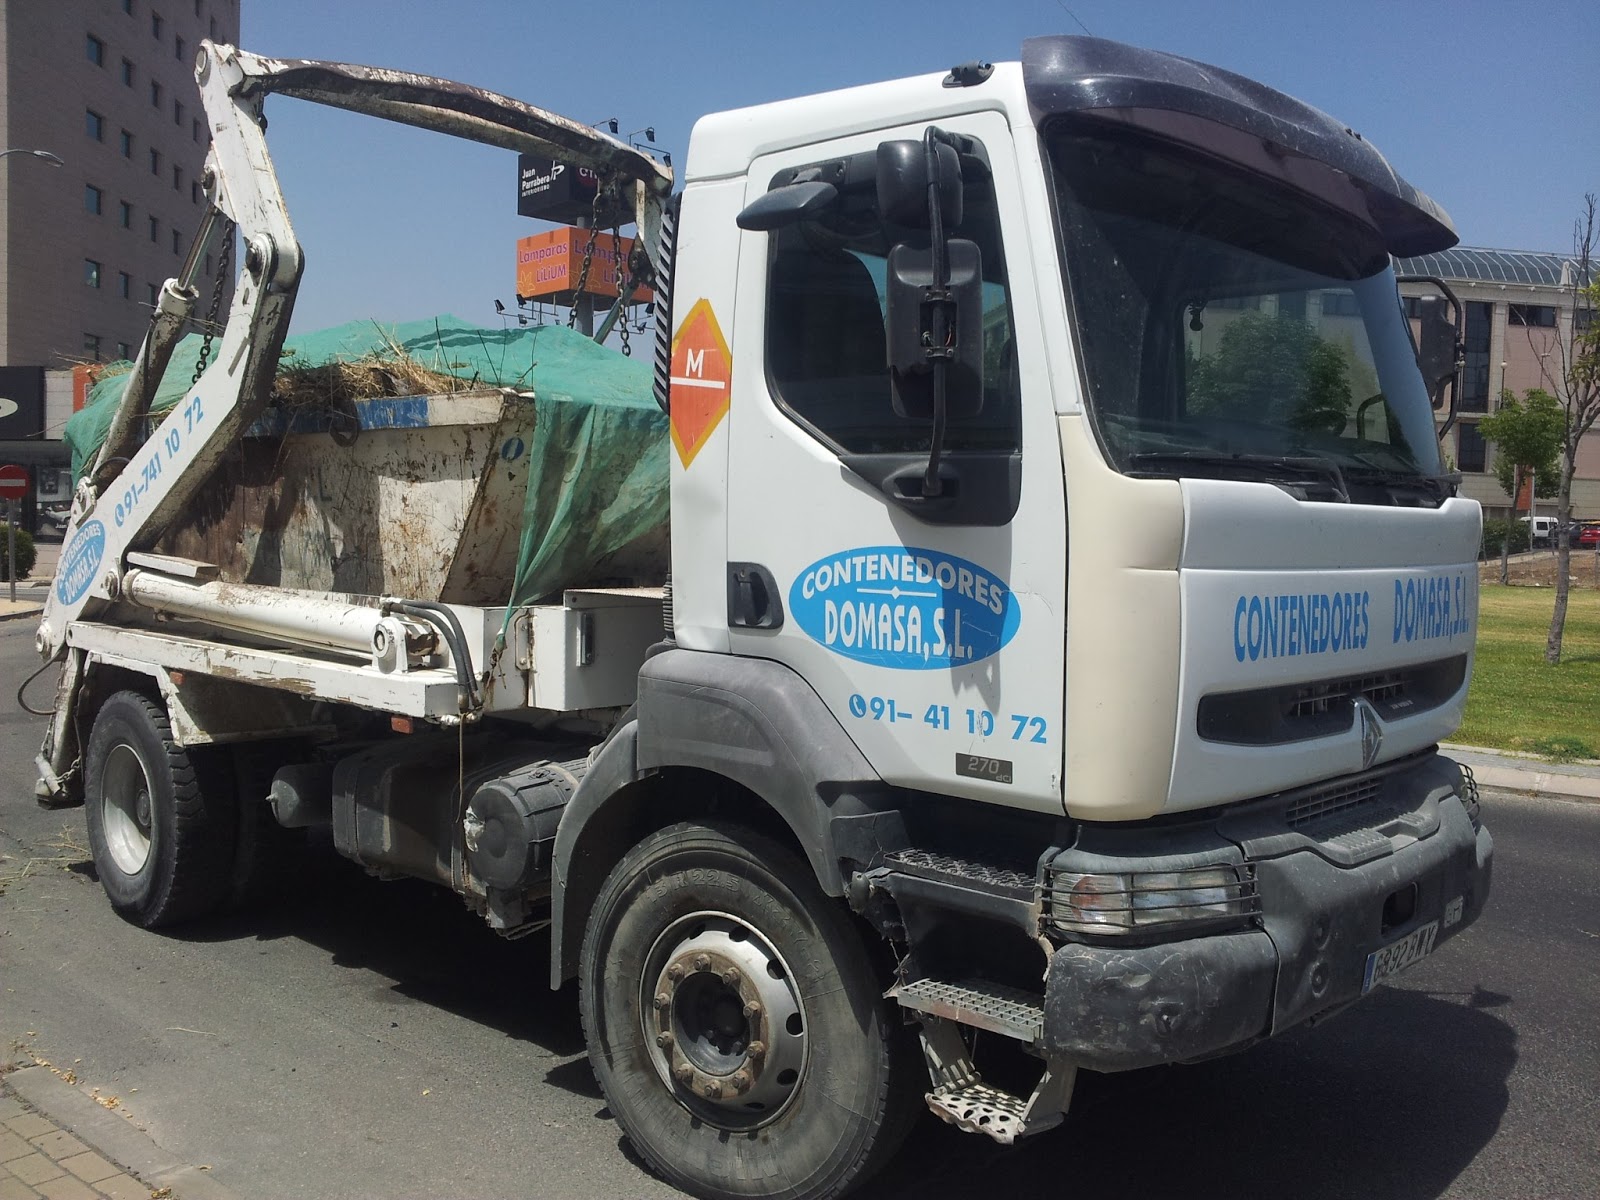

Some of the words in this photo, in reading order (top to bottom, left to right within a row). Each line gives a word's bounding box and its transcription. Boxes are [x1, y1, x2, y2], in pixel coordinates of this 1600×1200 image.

[521, 175, 550, 191] Parrabera
[522, 168, 536, 180] Juan
[519, 242, 568, 264] Lamparas
[685, 348, 705, 378] M
[165, 428, 180, 459] 10
[184, 396, 204, 434] 72
[802, 554, 1003, 615] CONTENEDORES
[1234, 590, 1369, 663] CONTENEDORES
[965, 709, 994, 737] 10
[1010, 714, 1047, 744] 72
[968, 756, 1000, 774] 270
